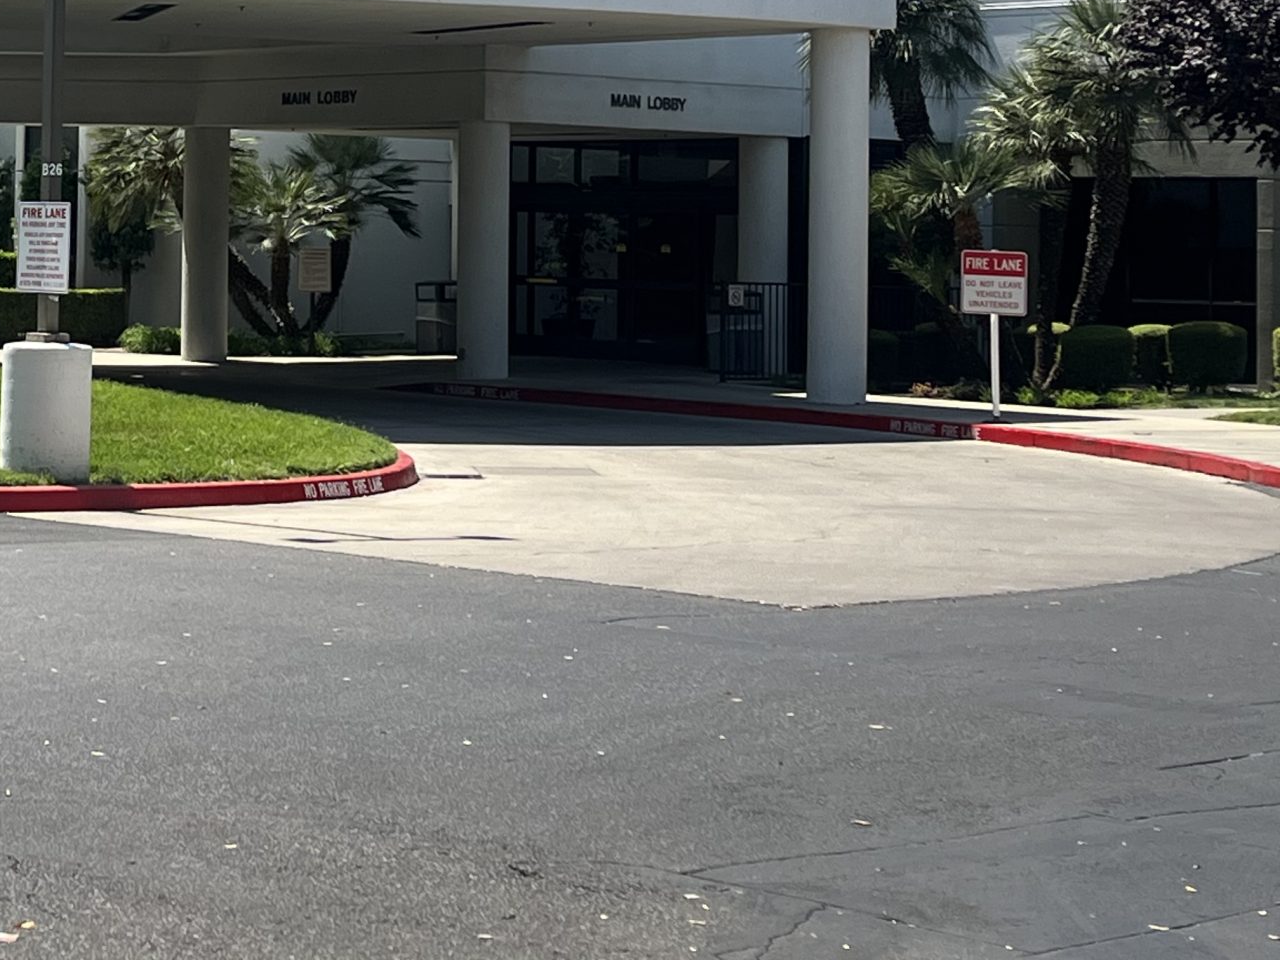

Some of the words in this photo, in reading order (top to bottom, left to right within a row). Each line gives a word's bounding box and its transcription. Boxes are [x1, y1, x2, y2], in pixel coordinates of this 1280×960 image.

[281, 91, 311, 105] MAIN
[317, 89, 357, 104] LOBBY
[610, 93, 641, 109] MAIN
[647, 95, 686, 112] LOBBY
[42, 163, 63, 176] B26
[22, 207, 43, 219] FIRE
[45, 208, 66, 219] LANE
[965, 257, 990, 270] FIRE
[992, 258, 1023, 271] LANE
[998, 281, 1023, 289] LEAVE
[976, 290, 1013, 299] VEHICLES
[303, 483, 317, 499] NO
[318, 480, 351, 498] PARKING
[352, 479, 370, 495] FIRE
